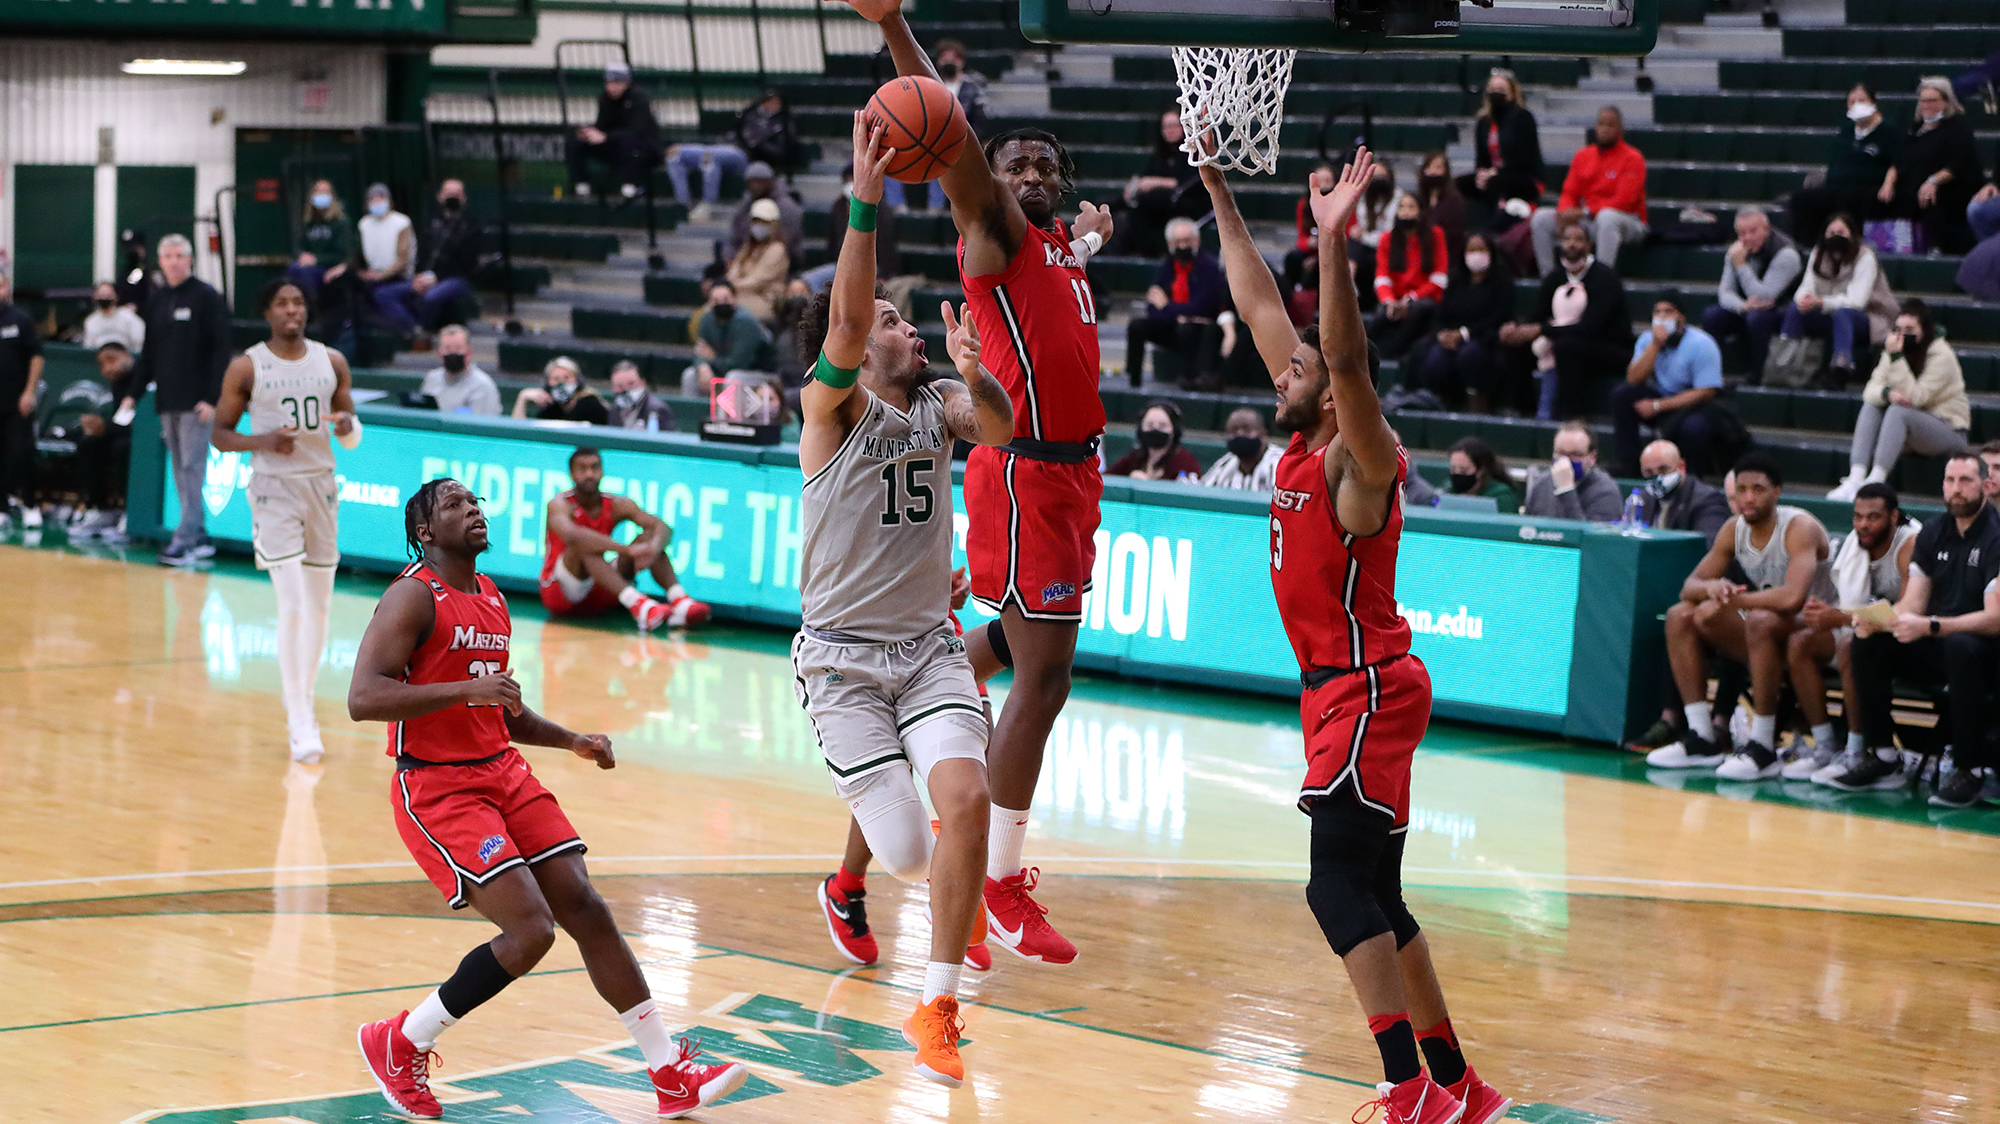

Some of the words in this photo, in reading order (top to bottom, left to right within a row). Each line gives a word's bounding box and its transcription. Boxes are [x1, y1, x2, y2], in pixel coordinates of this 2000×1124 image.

[1069, 277, 1097, 325] 11
[281, 396, 320, 432] 30
[880, 457, 936, 527] 15
[1041, 583, 1075, 606] MAAC
[478, 834, 506, 864] MAAC
